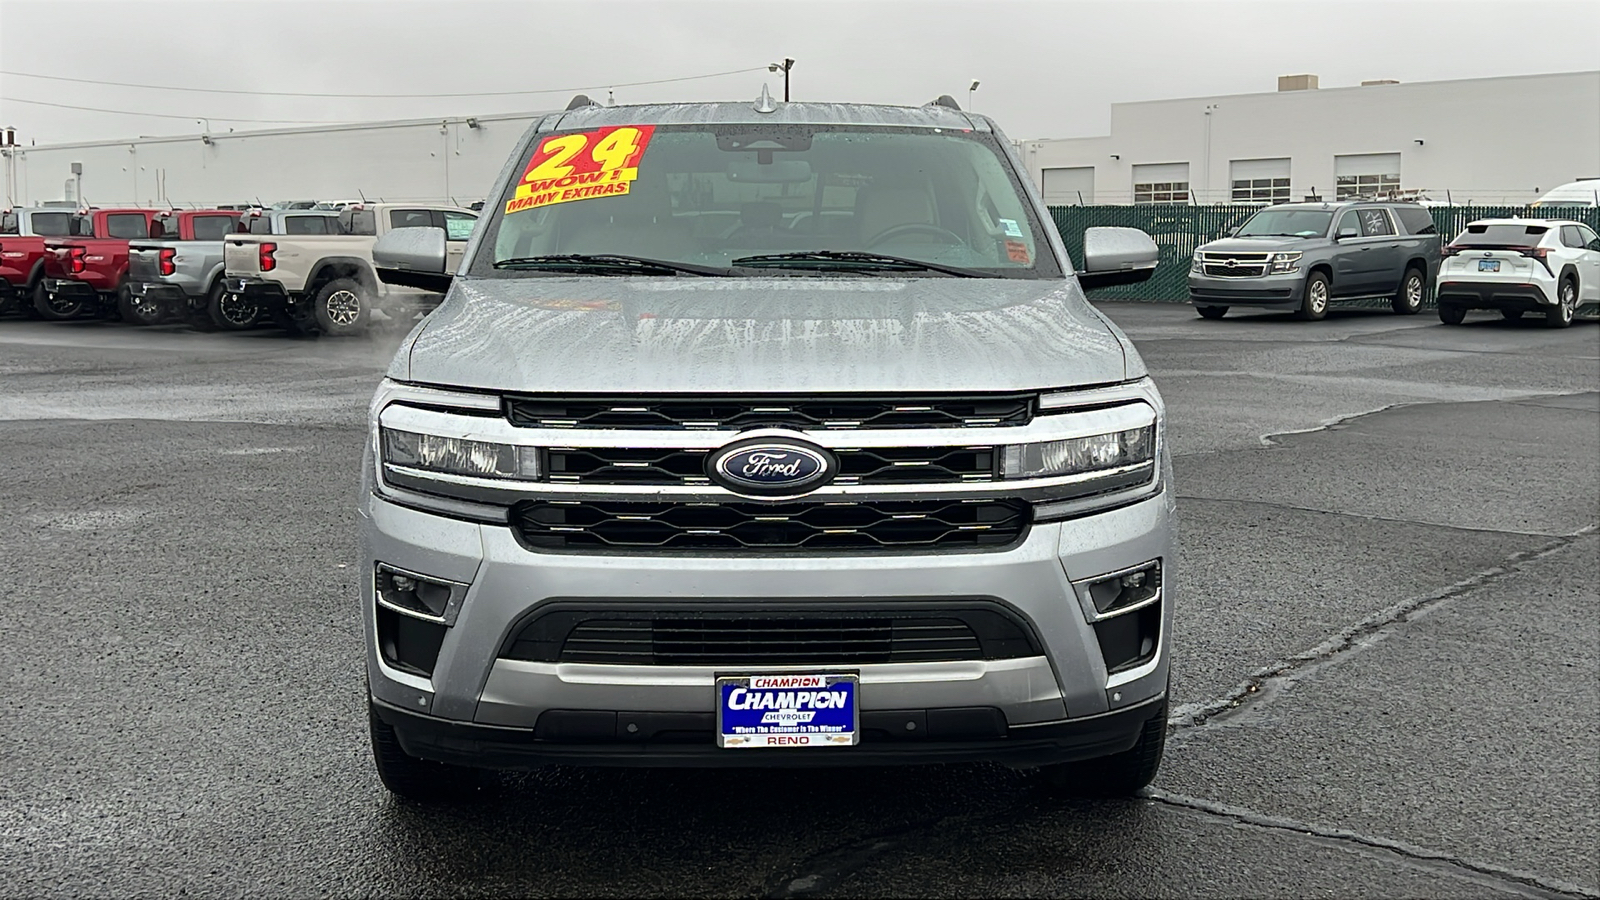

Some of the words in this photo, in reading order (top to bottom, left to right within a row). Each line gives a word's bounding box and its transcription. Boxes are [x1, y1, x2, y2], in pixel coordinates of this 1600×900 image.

[525, 127, 642, 182] 24
[507, 191, 559, 212] MANY
[561, 181, 628, 201] EXTRAS
[742, 452, 802, 477] Ford
[755, 678, 820, 688] CHAMPION
[765, 713, 811, 721] CHEVROLET
[766, 736, 810, 745] RENO
